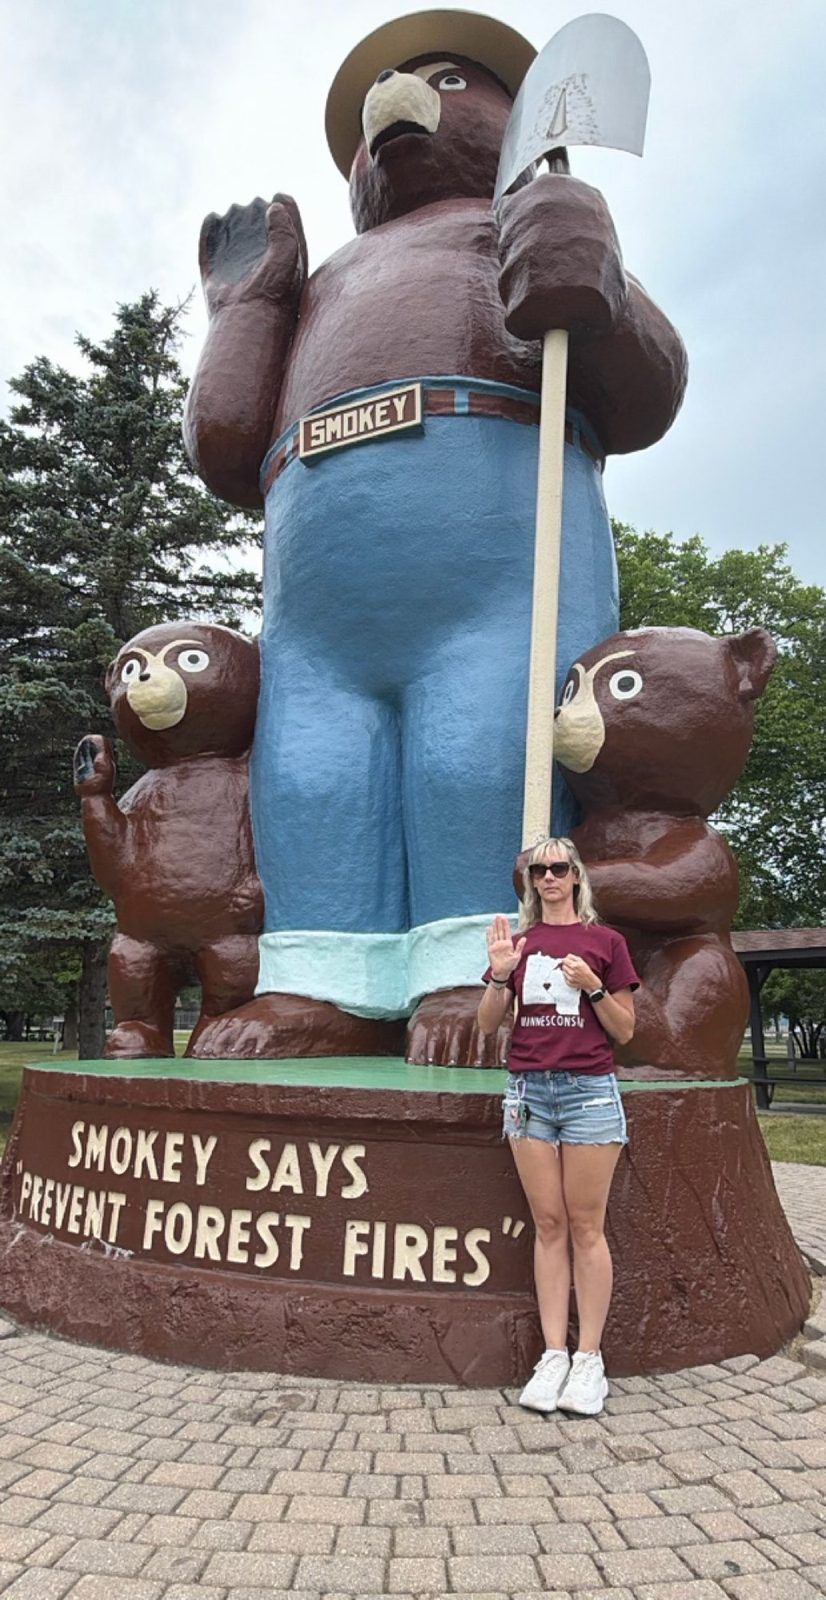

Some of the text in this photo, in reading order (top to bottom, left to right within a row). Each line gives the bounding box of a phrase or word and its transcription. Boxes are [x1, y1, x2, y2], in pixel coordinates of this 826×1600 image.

[311, 394, 407, 447] SMOKEY
[67, 1120, 369, 1200] SMOKEY SAYS
[142, 1199, 311, 1271] FOREST
